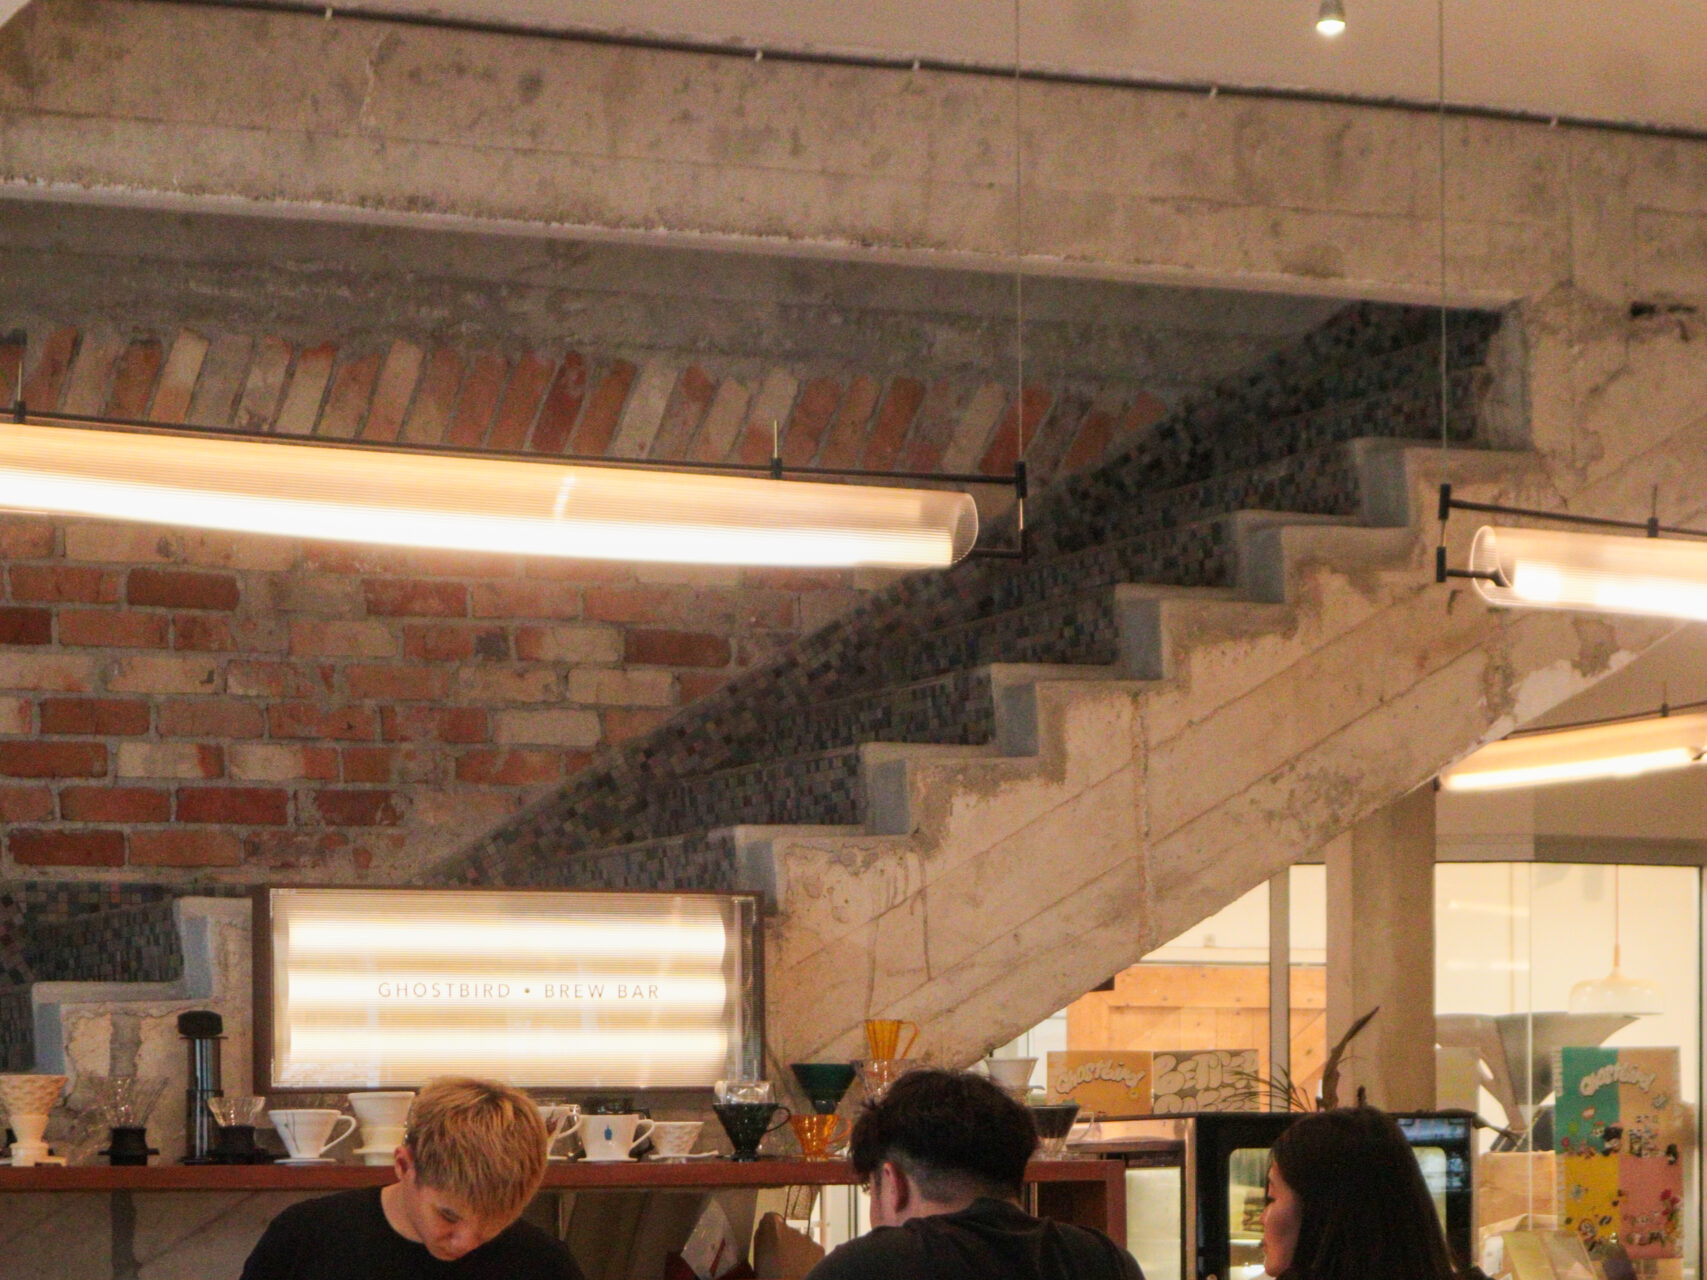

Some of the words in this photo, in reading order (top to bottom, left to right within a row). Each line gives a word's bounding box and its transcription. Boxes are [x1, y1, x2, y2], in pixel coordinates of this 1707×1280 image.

[378, 982, 511, 998] GHOSTBIRD
[544, 983, 605, 999] BREW
[617, 983, 660, 999] BAR
